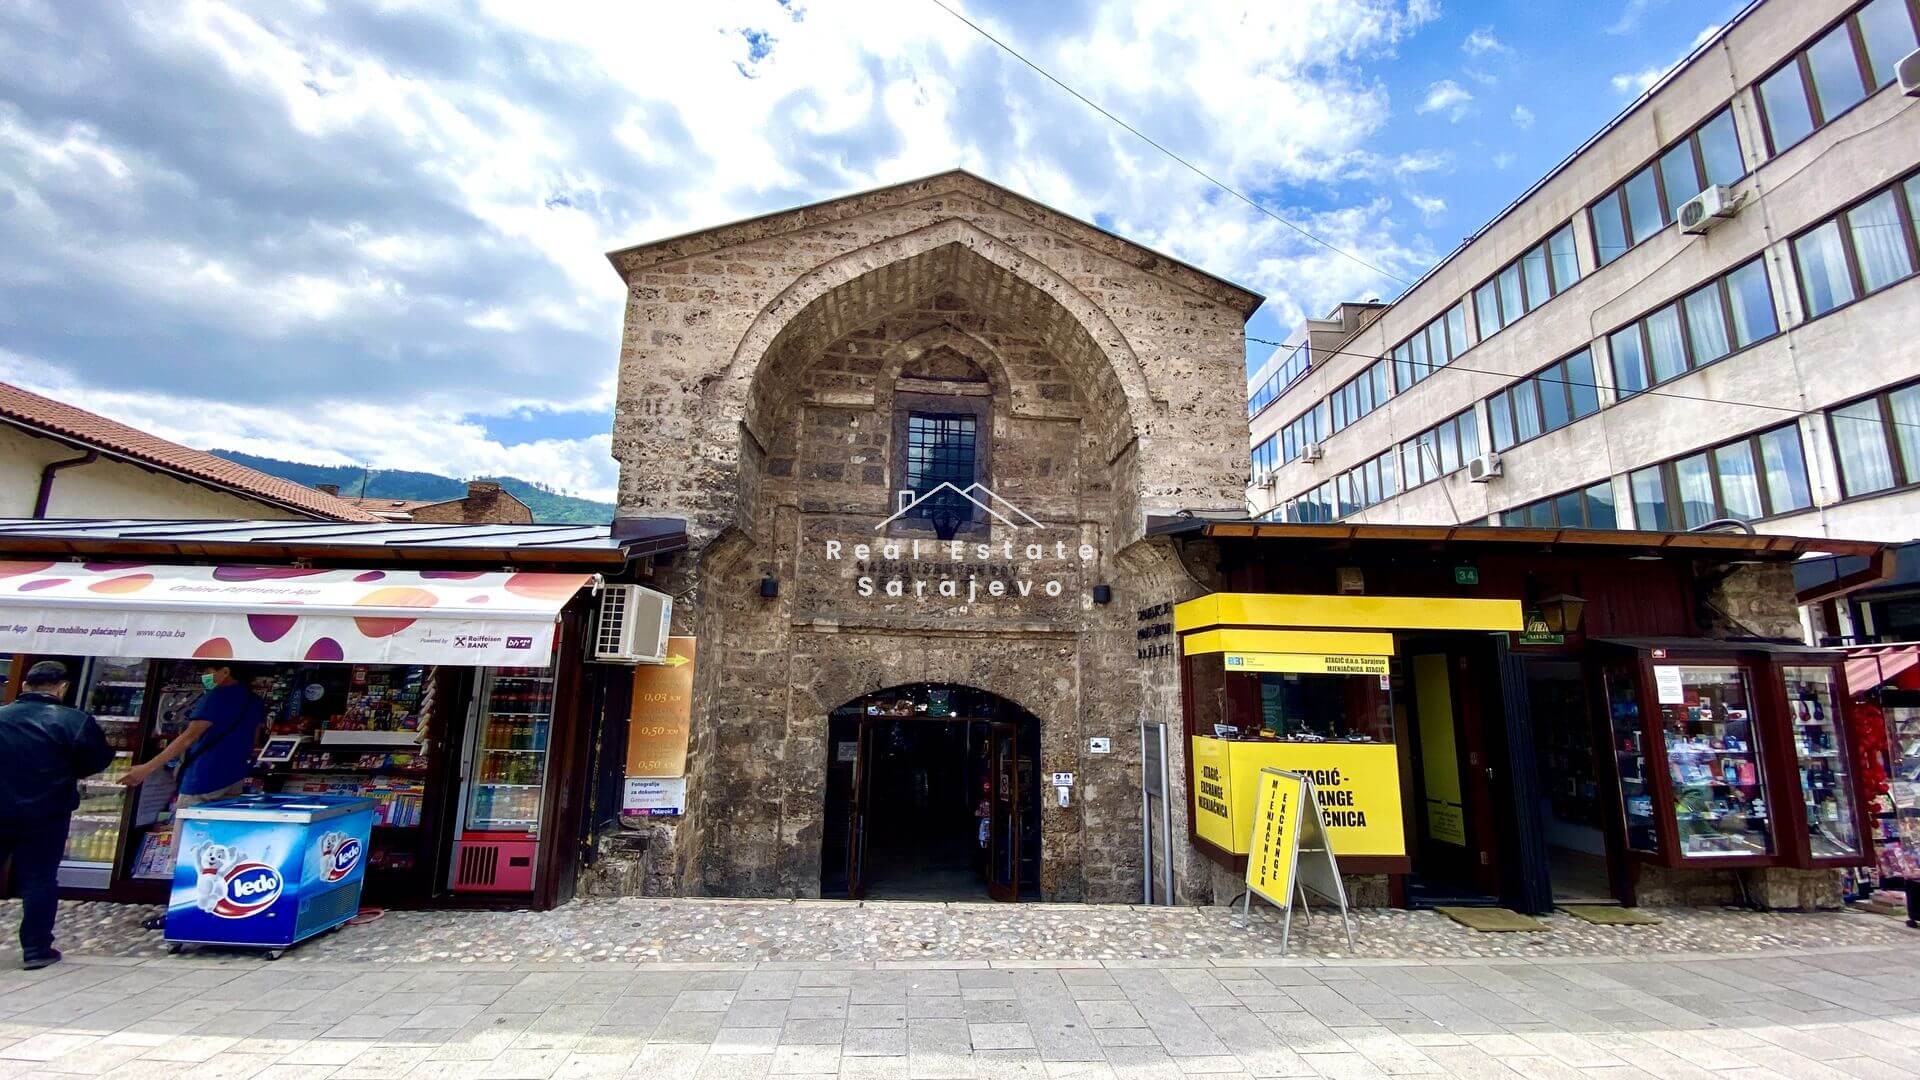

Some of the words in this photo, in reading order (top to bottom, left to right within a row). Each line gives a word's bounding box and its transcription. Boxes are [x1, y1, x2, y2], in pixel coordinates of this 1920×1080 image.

[1458, 571, 1475, 580] 34
[12, 624, 28, 633] App
[36, 625, 56, 633] Brzo
[57, 626, 89, 635] mobilno
[136, 629, 186, 638] www.opa.ba
[641, 726, 665, 736] 0,50
[1292, 767, 1341, 786] AGIĆ
[1318, 790, 1354, 806] ANGE
[338, 845, 359, 865] ledo
[234, 875, 276, 897] ledo
